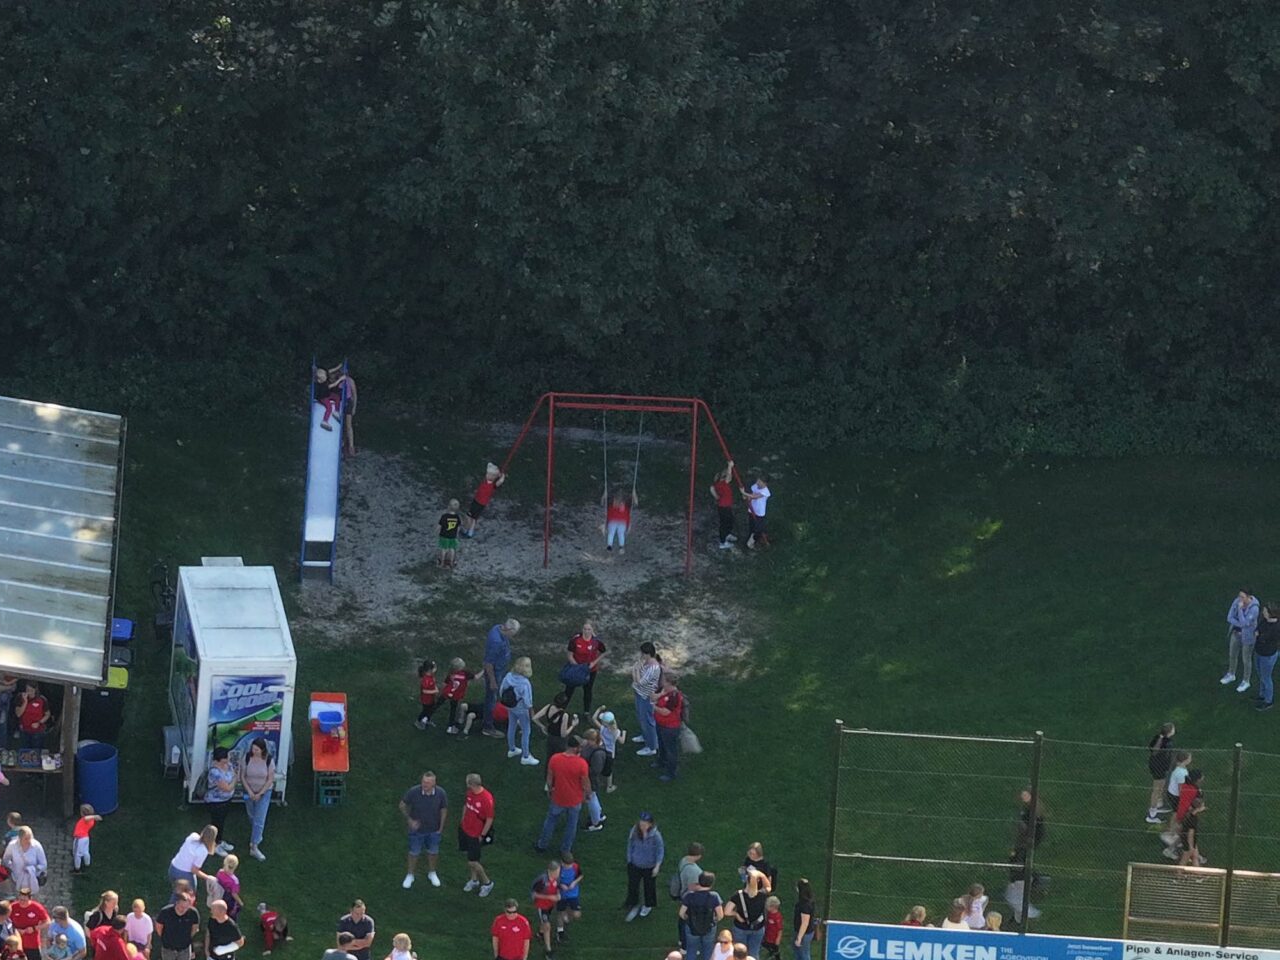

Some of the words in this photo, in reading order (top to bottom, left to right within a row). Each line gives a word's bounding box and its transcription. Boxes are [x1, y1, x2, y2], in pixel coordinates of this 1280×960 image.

[1000, 946, 1014, 954] THE
[1125, 944, 1150, 954] Pipe
[1166, 947, 1259, 960] Anlagen-Service
